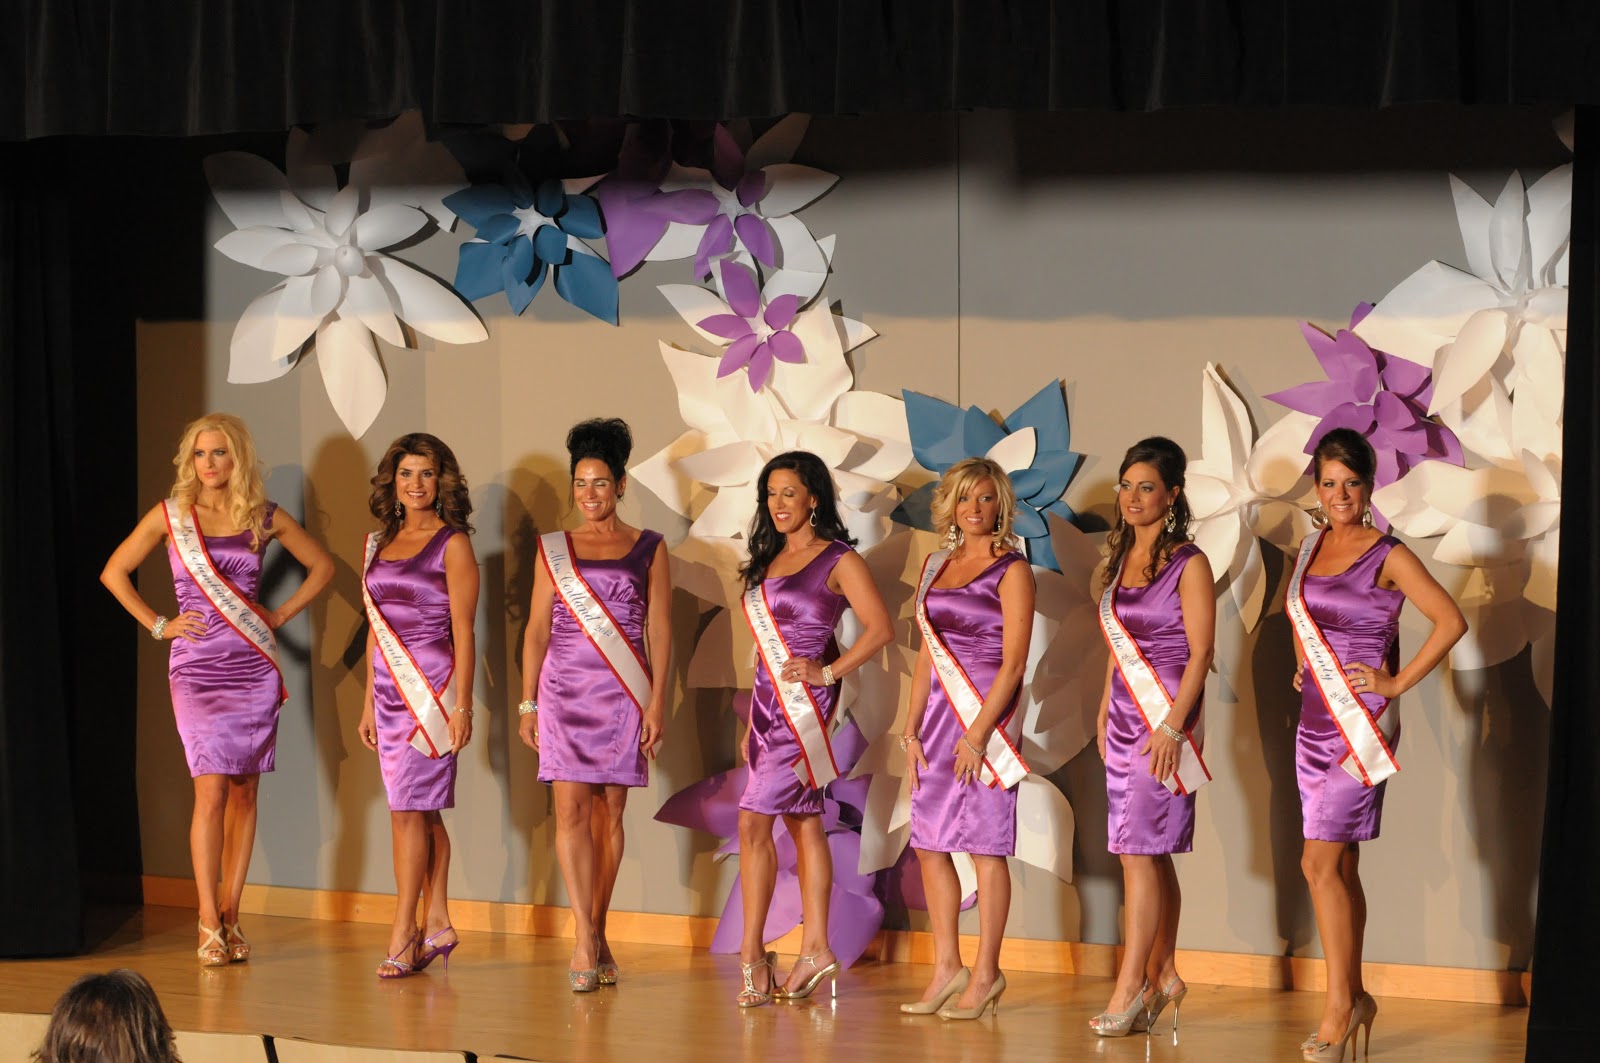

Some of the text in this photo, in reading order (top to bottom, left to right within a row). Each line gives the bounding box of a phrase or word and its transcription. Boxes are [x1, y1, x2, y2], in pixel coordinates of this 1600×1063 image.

[188, 546, 237, 611] Columbiana
[238, 608, 269, 644] County
[549, 550, 614, 637] Mrs. Cortland 2012
[378, 626, 416, 685] County 2012
[939, 663, 954, 677] 2012
[1121, 653, 1138, 667] 2012
[1307, 632, 1334, 681] County
[1329, 691, 1350, 705] 2012
